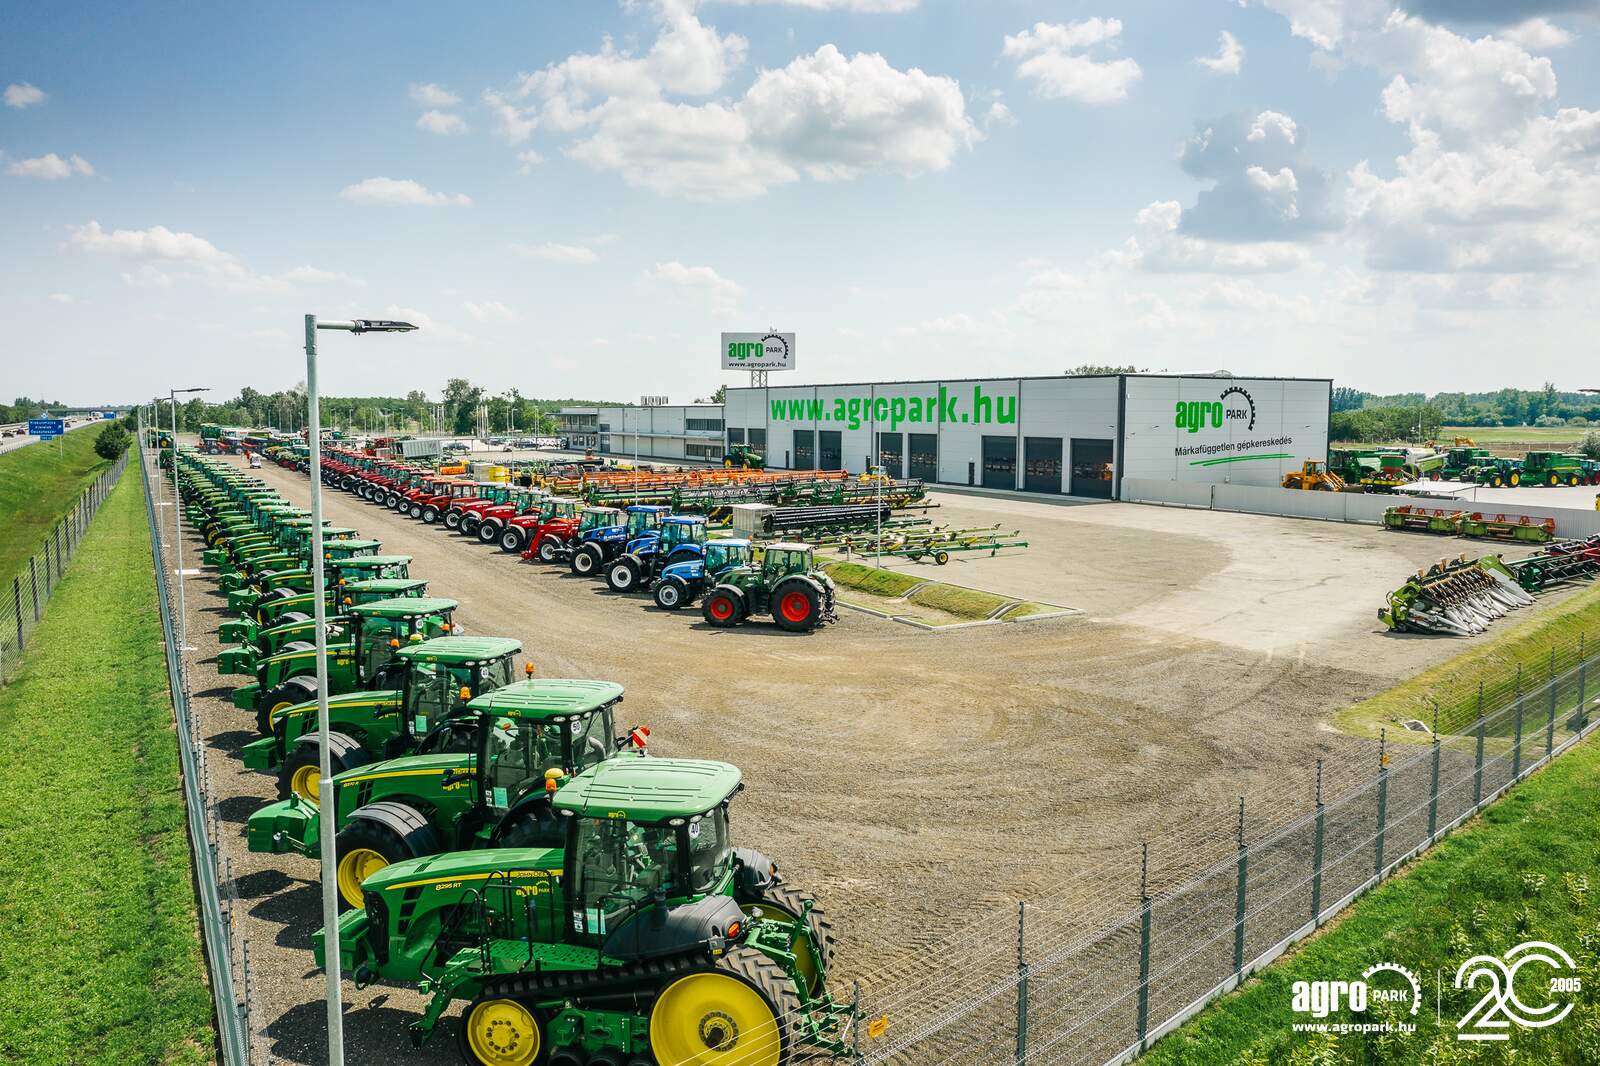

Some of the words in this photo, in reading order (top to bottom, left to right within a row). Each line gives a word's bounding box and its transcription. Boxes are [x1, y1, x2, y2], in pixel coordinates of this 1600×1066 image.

[728, 342, 764, 360] agro
[770, 385, 1016, 431] www.agropark.hu
[1175, 401, 1223, 433] agro
[1226, 409, 1248, 420] PARK
[1175, 442, 1236, 457] Márkafüggetlen
[1236, 436, 1293, 452] gépkereskedés
[690, 823, 699, 834] 40
